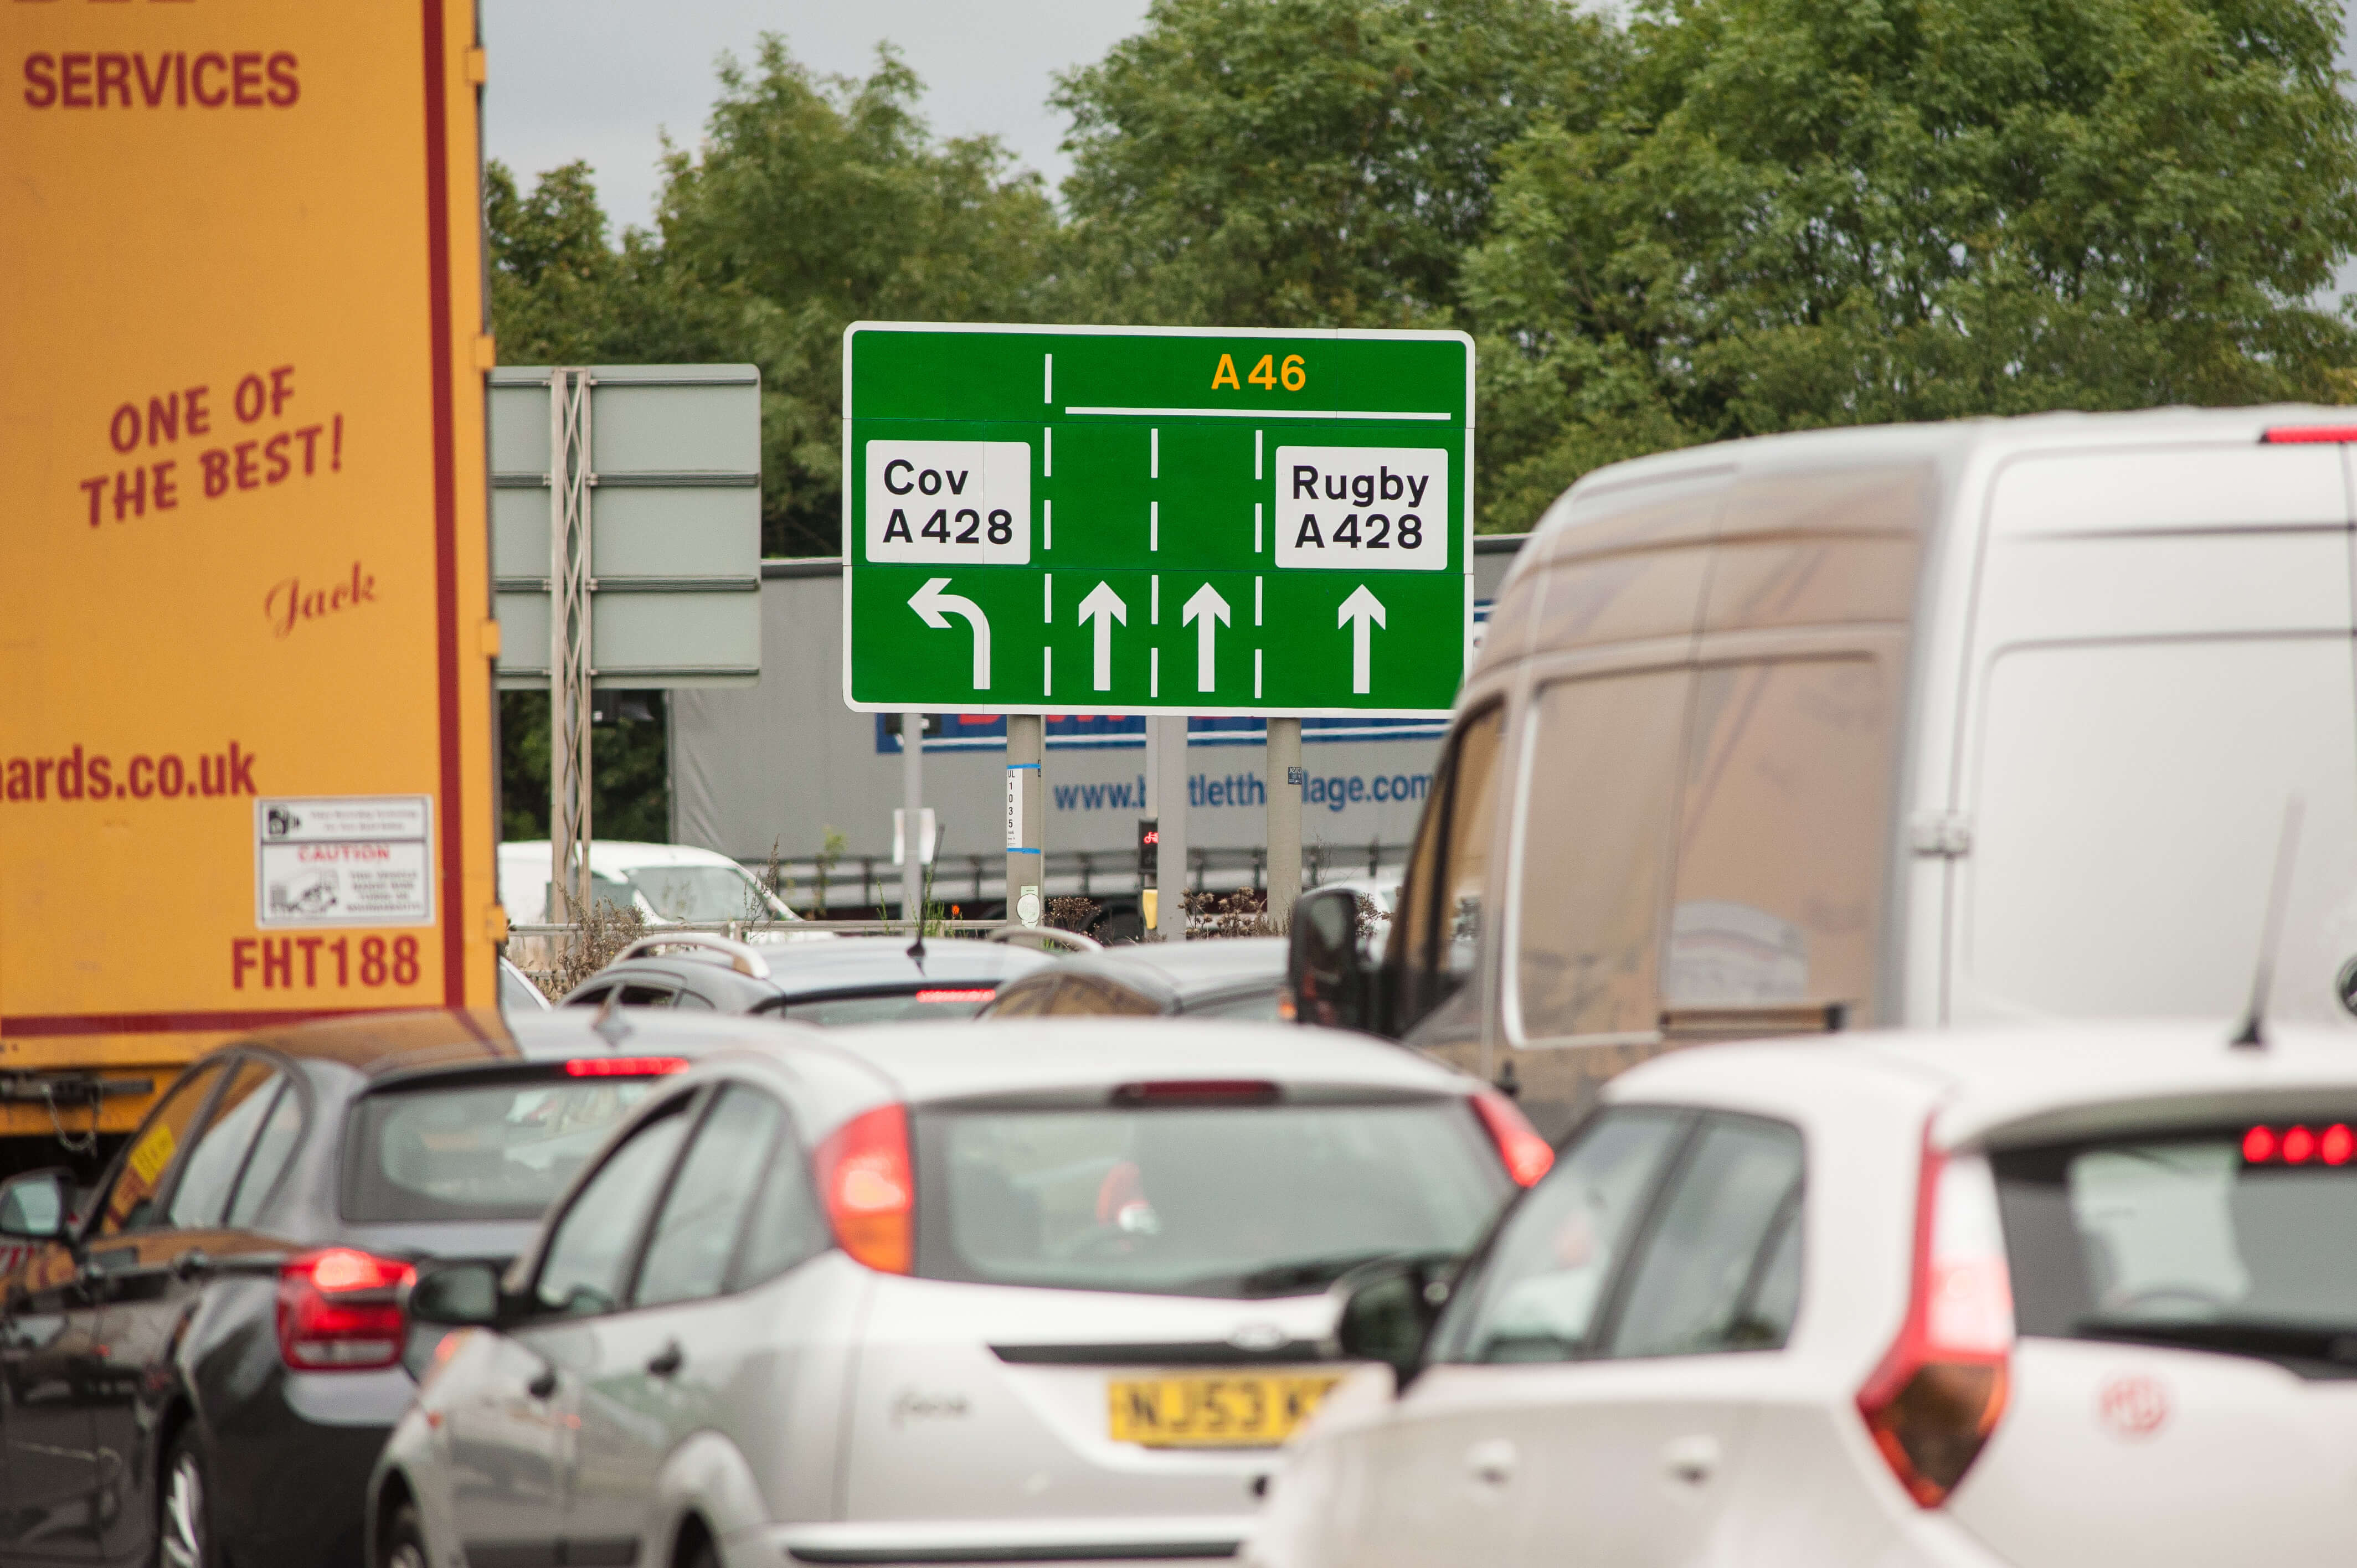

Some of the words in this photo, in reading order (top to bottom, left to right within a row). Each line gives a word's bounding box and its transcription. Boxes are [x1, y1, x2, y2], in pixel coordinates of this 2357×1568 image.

[23, 50, 301, 110] SERVICES
[1211, 353, 1306, 391] A46
[110, 385, 212, 454] ONE
[234, 365, 295, 425] OF
[80, 460, 178, 529] THE
[199, 413, 343, 499] BEST!
[884, 458, 969, 496] Cov
[1292, 465, 1429, 508] Rugby
[883, 508, 1013, 545] A428
[1294, 513, 1423, 549] A428
[264, 561, 378, 639] Jack
[0, 741, 258, 801] ards.co.uk
[297, 845, 390, 863] CAUTION
[231, 934, 420, 989] FHT188
